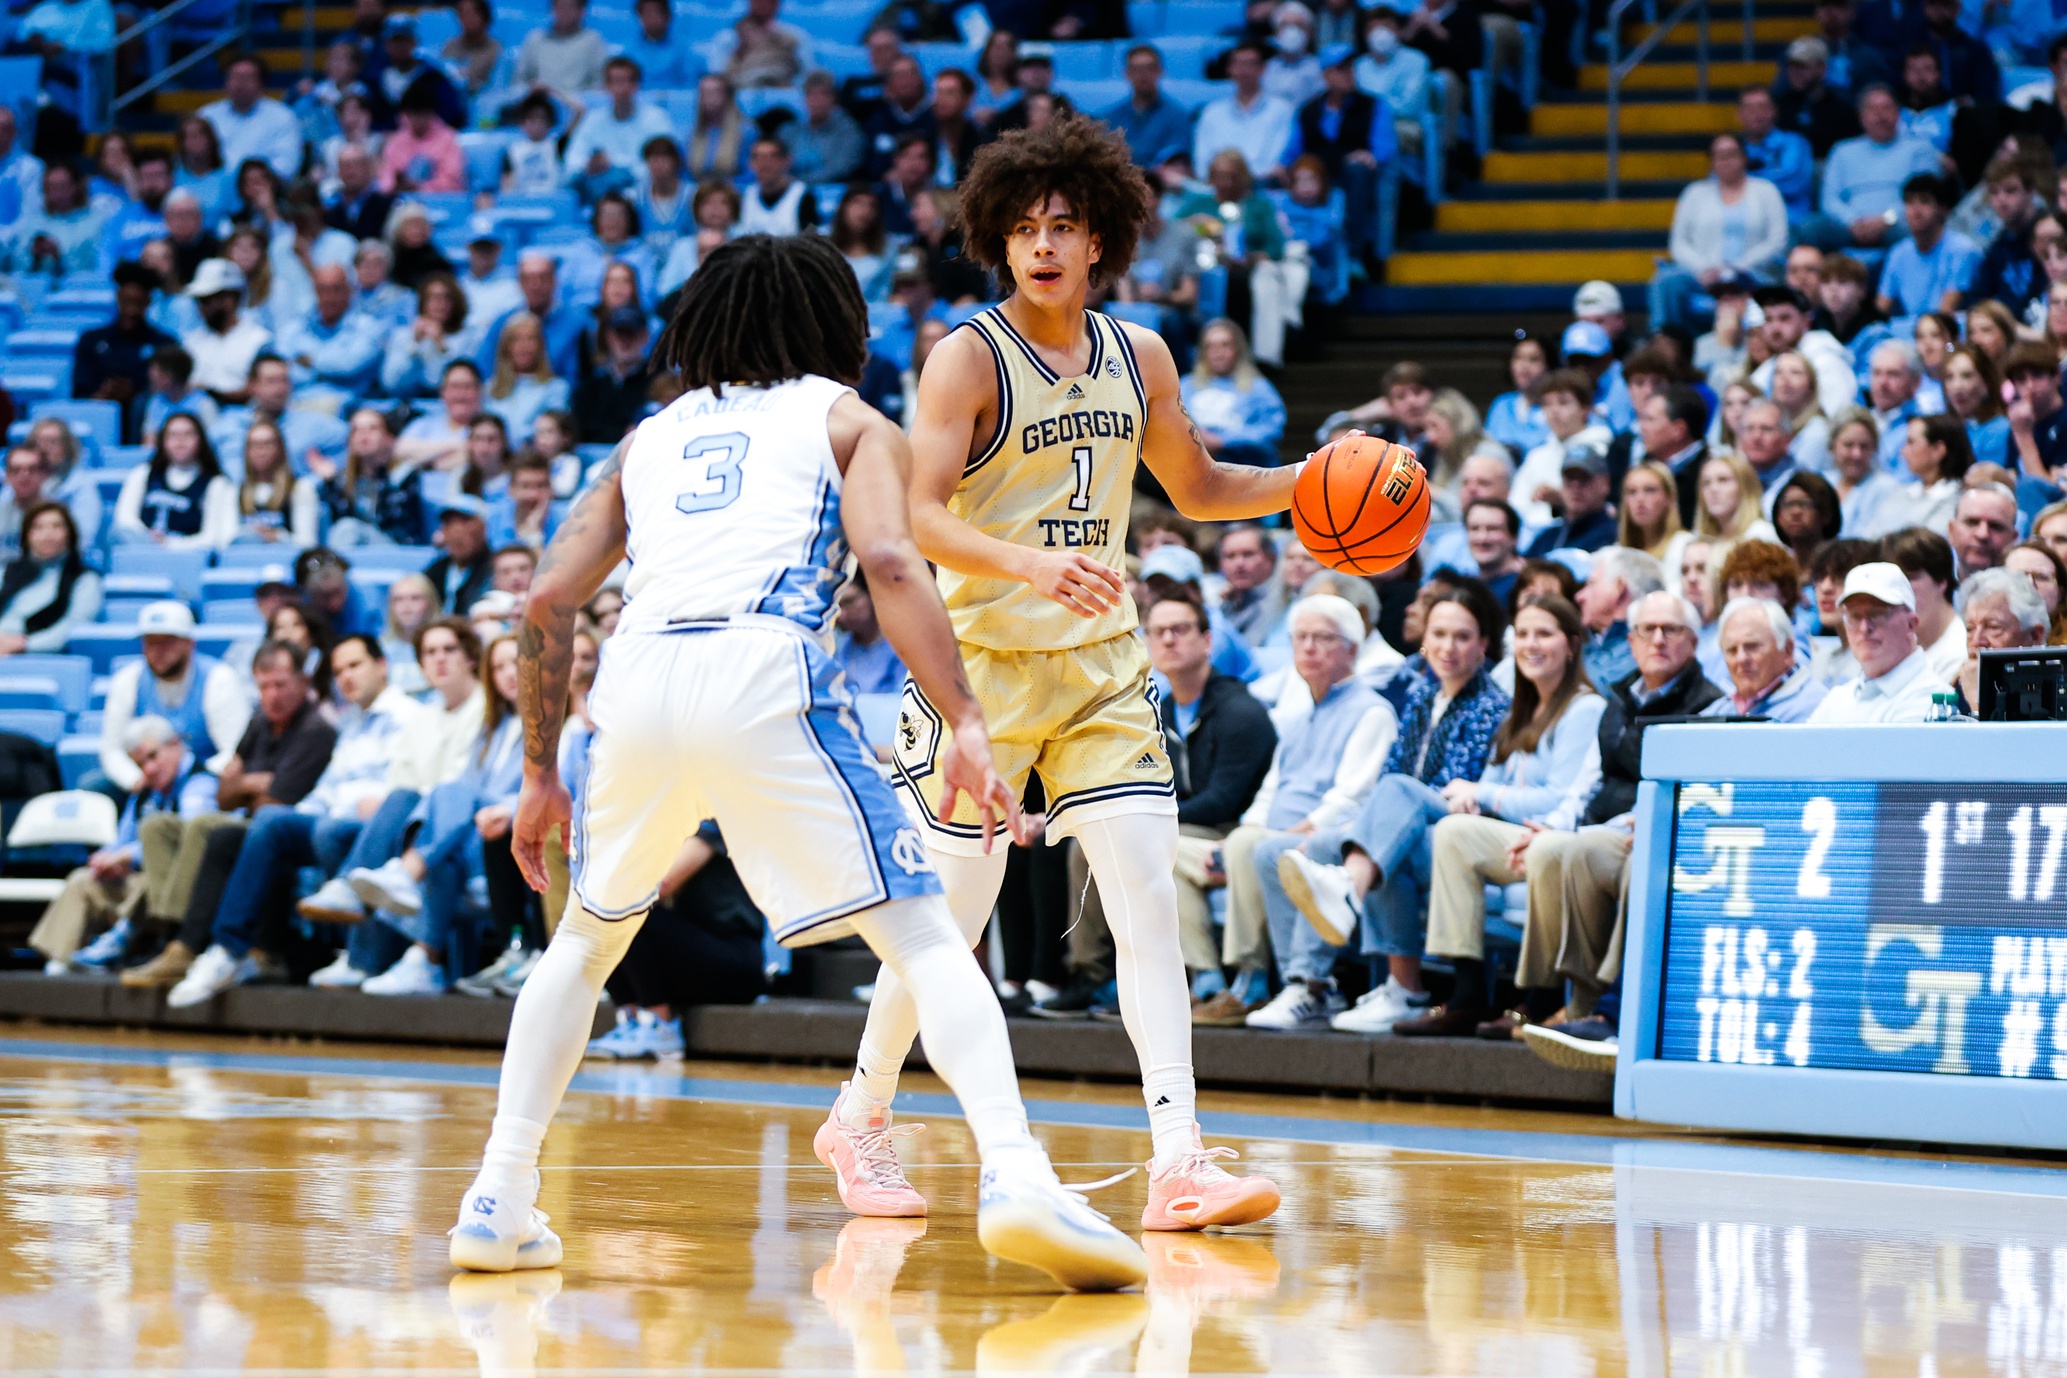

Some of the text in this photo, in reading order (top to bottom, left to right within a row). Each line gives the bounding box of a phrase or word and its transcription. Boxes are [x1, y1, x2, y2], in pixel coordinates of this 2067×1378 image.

[1022, 410, 1134, 455] GEORGIA
[675, 431, 751, 514] 3
[1068, 446, 1092, 511] 1
[1385, 452, 1417, 506] ELITE
[1038, 519, 1109, 546] TECH
[1797, 796, 1836, 898] 2
[1701, 926, 1817, 999] FLS: 2
[1696, 997, 1813, 1067] TOL: 4
